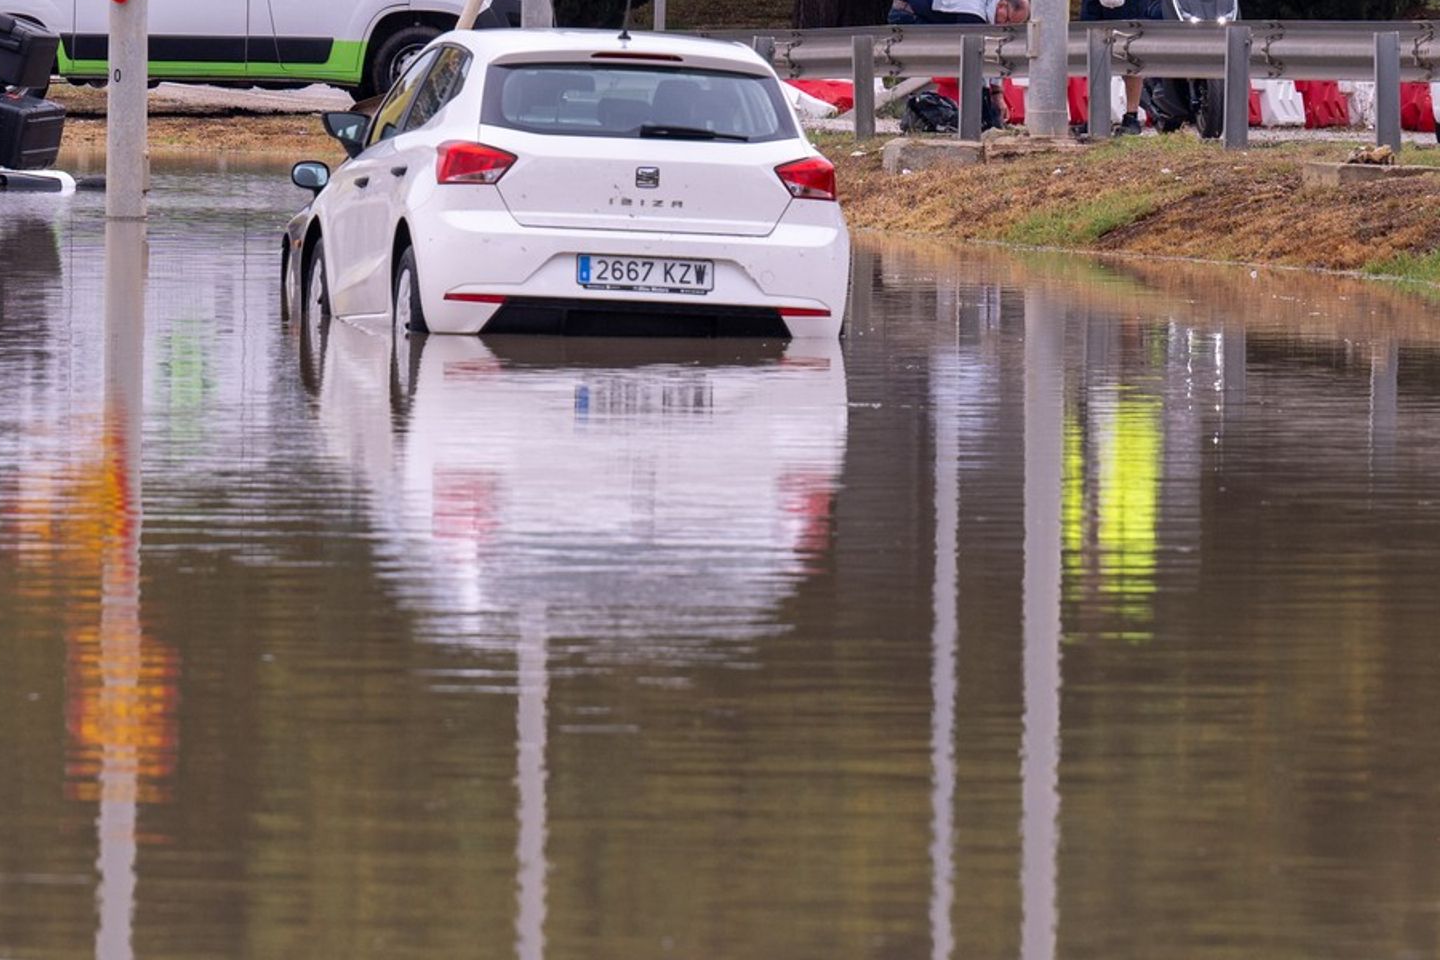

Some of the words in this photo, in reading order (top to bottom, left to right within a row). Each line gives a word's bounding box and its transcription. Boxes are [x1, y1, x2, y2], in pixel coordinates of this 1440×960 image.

[608, 197, 684, 209] IBIZA
[596, 259, 655, 283] 2667
[663, 262, 707, 285] KZW
